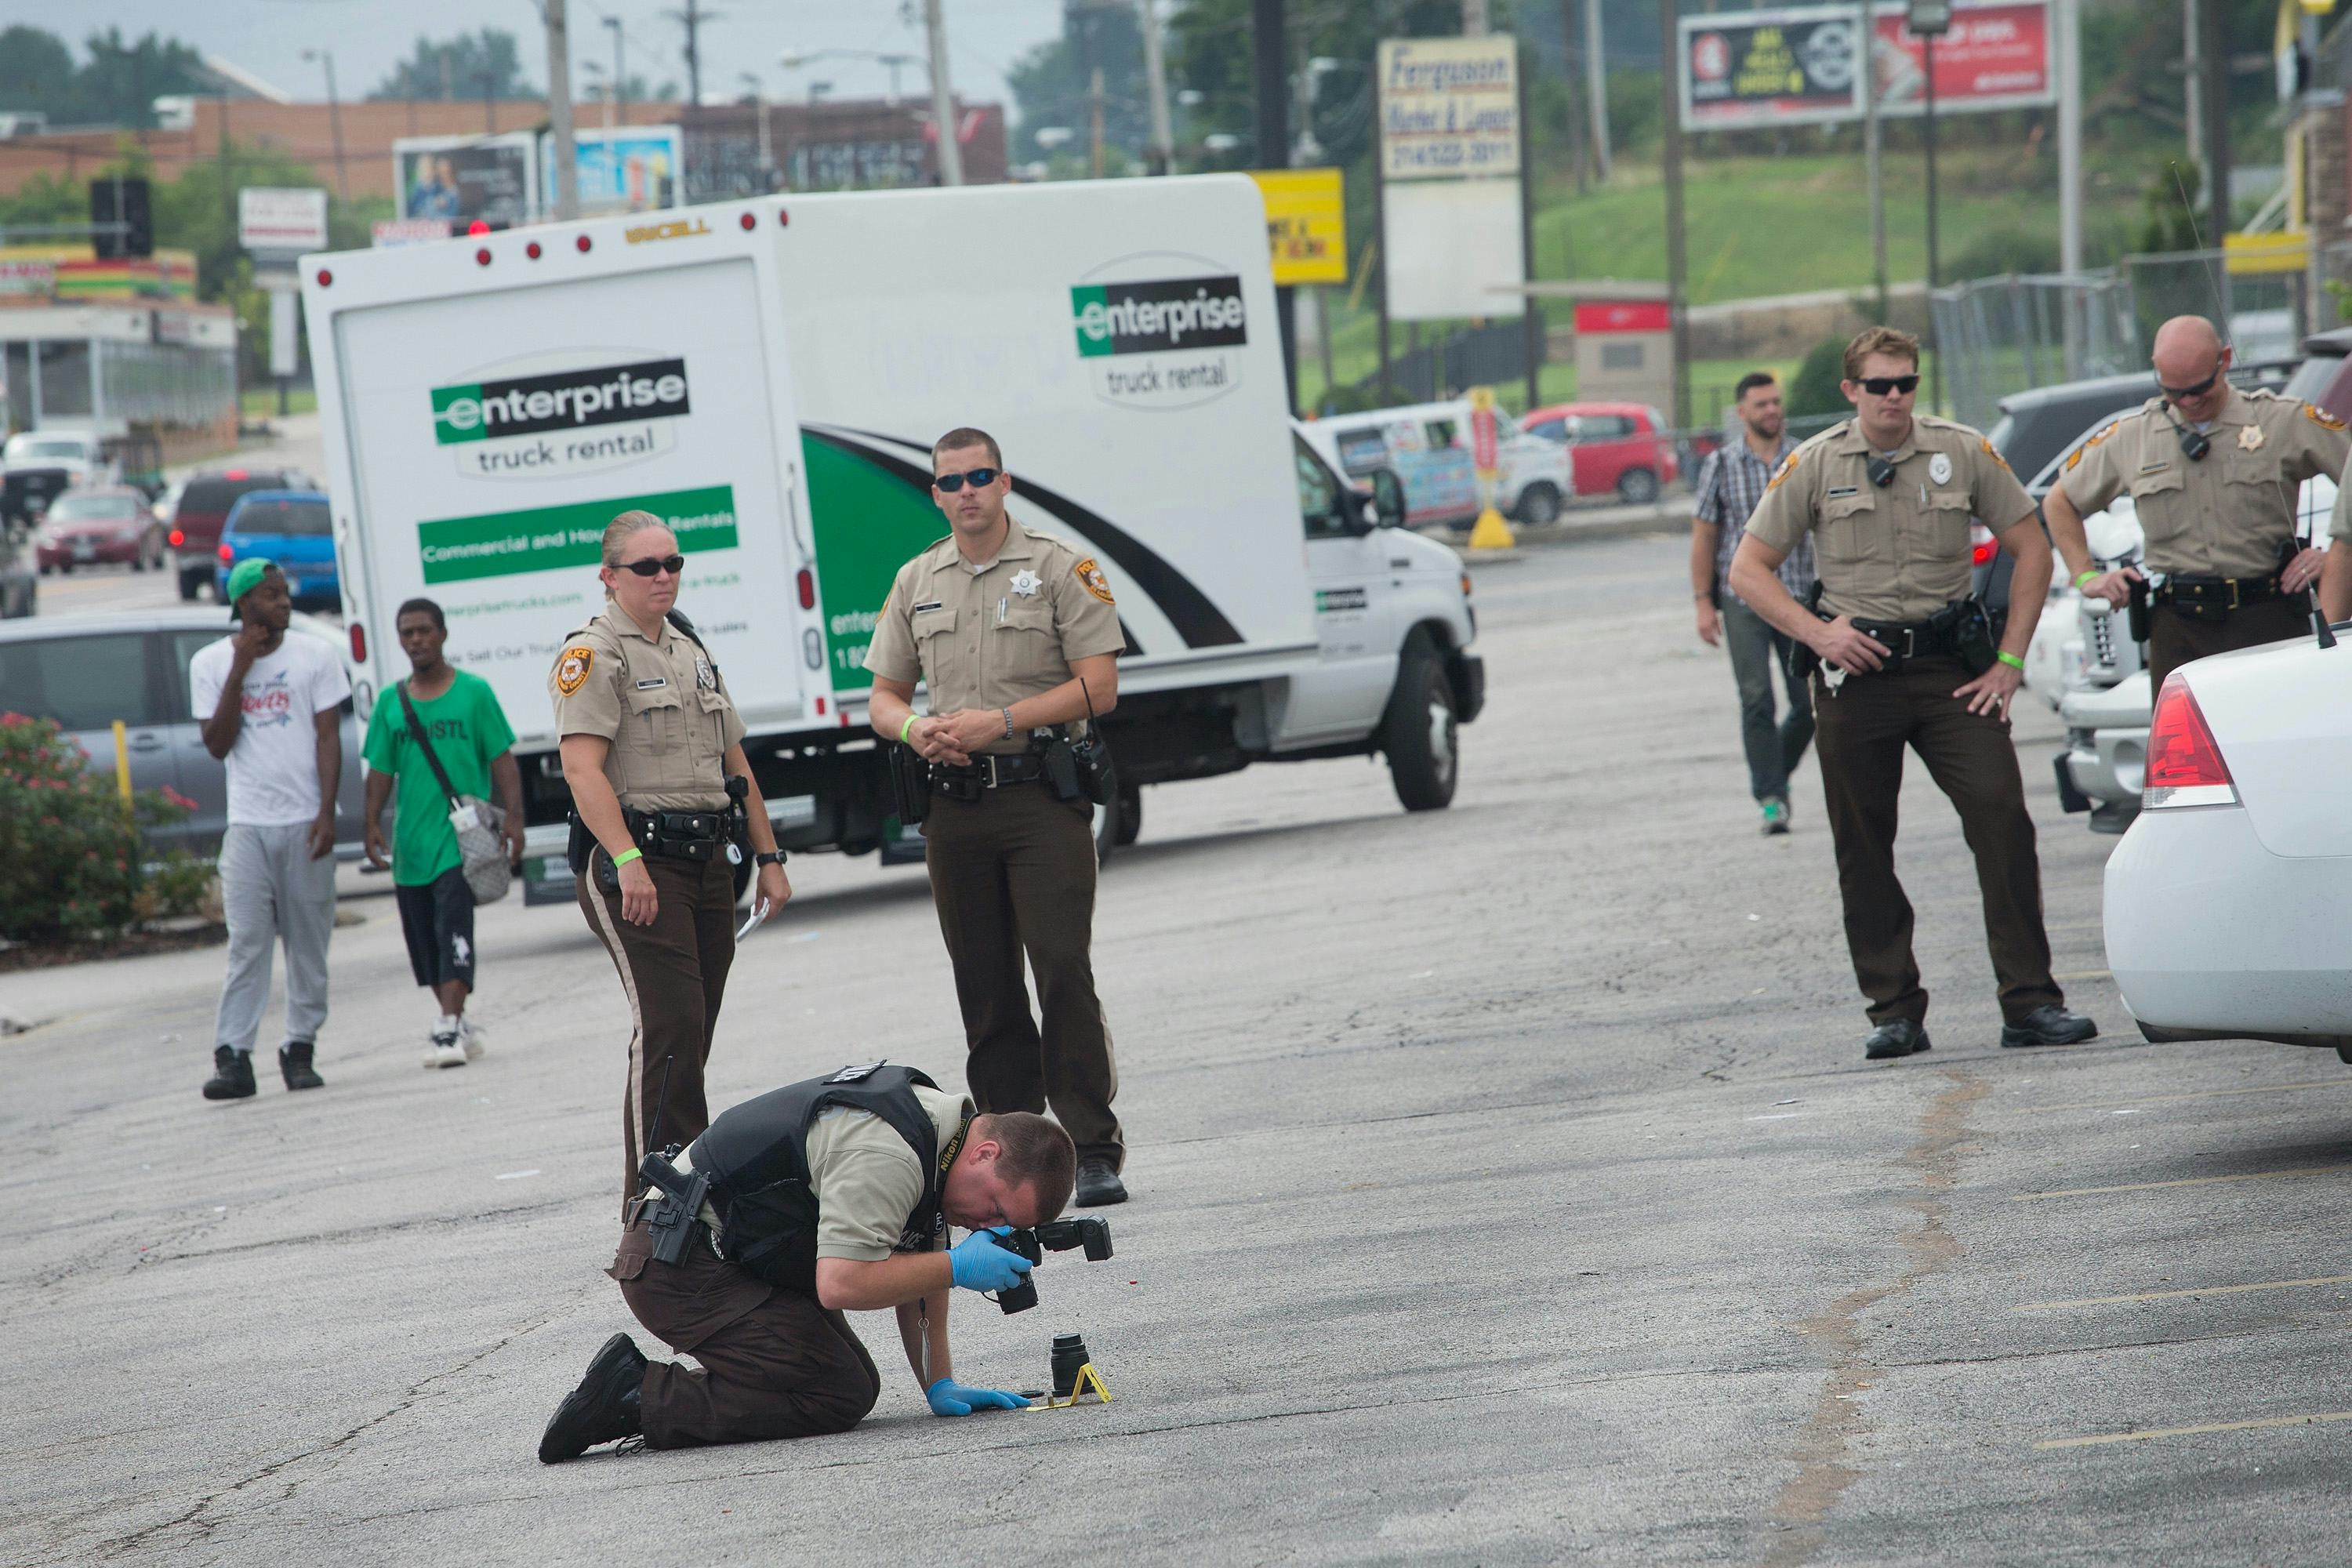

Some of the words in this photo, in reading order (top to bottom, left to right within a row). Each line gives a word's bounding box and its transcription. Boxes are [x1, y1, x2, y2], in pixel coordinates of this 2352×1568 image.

[1079, 287, 1243, 343] enterprise
[1107, 360, 1161, 395] truck
[1167, 354, 1228, 390] rental
[445, 372, 686, 430] enterprise
[478, 440, 554, 472] truck
[566, 426, 654, 461] rental
[423, 535, 528, 563] Commercial
[532, 530, 566, 550] and
[668, 510, 734, 532] Rentals
[466, 648, 491, 663] Sell
[495, 644, 523, 662] Our
[836, 648, 846, 670] 1
[941, 1139, 958, 1172] Nikon
